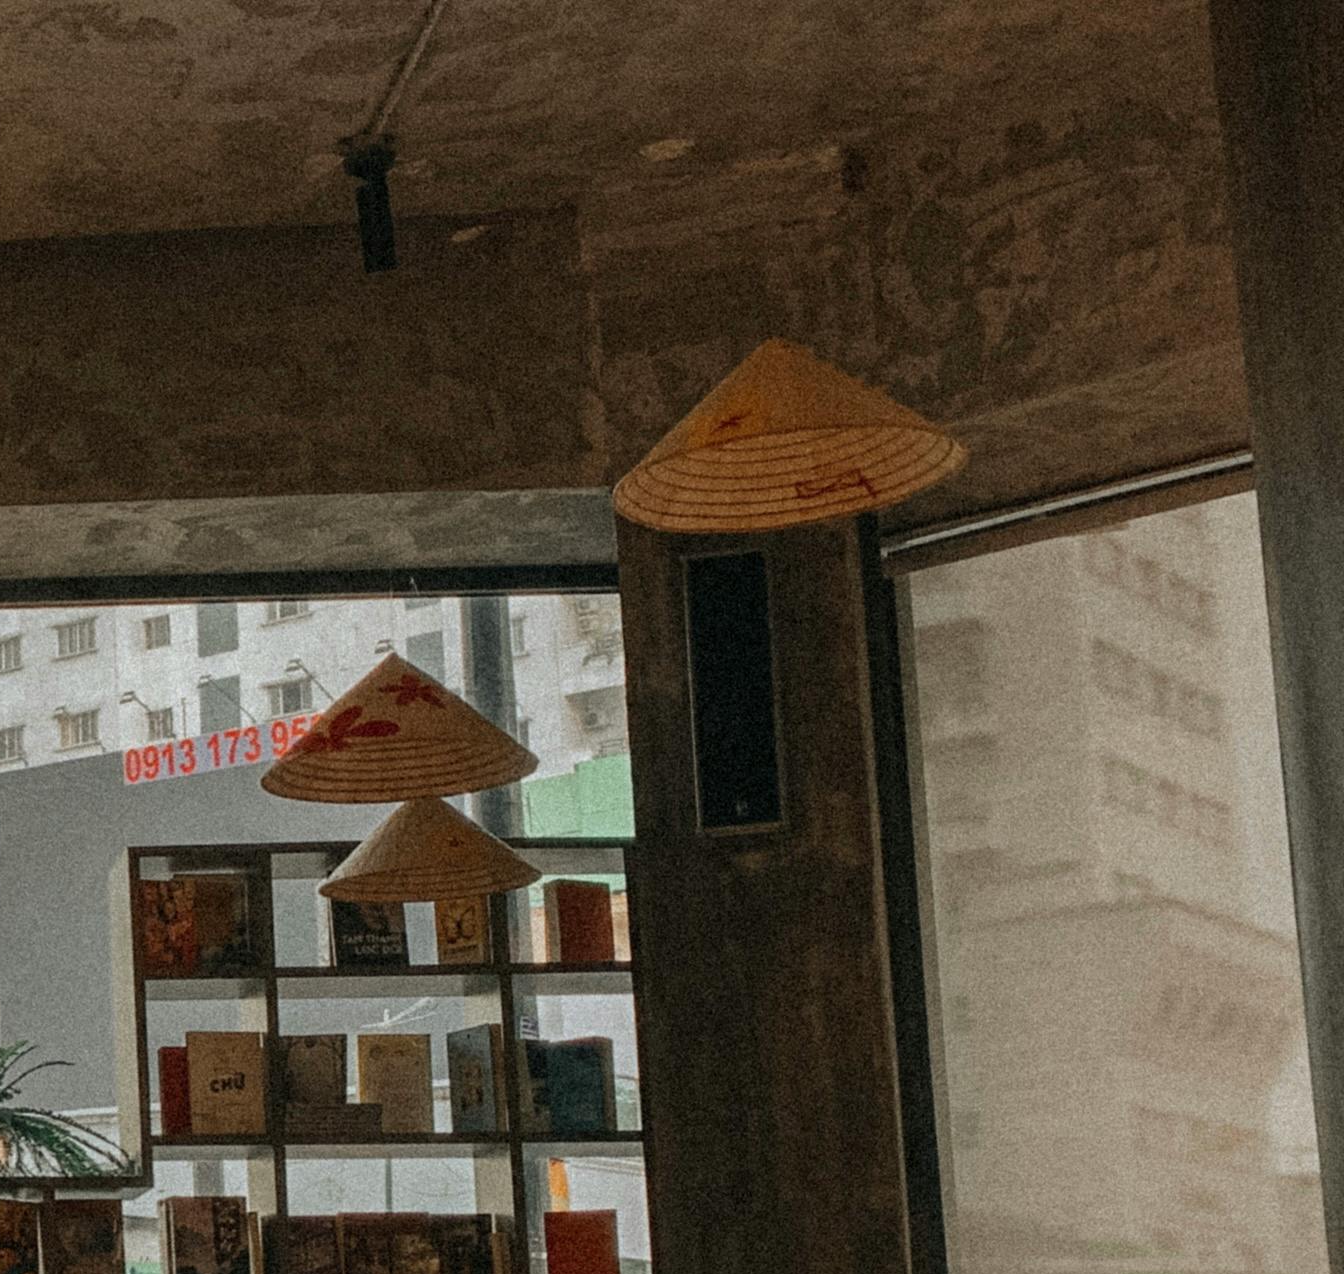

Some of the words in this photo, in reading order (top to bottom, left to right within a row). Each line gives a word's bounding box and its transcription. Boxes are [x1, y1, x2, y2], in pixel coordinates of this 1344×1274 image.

[125, 738, 197, 783] 0913
[207, 726, 261, 768] 173
[271, 713, 324, 758] 95
